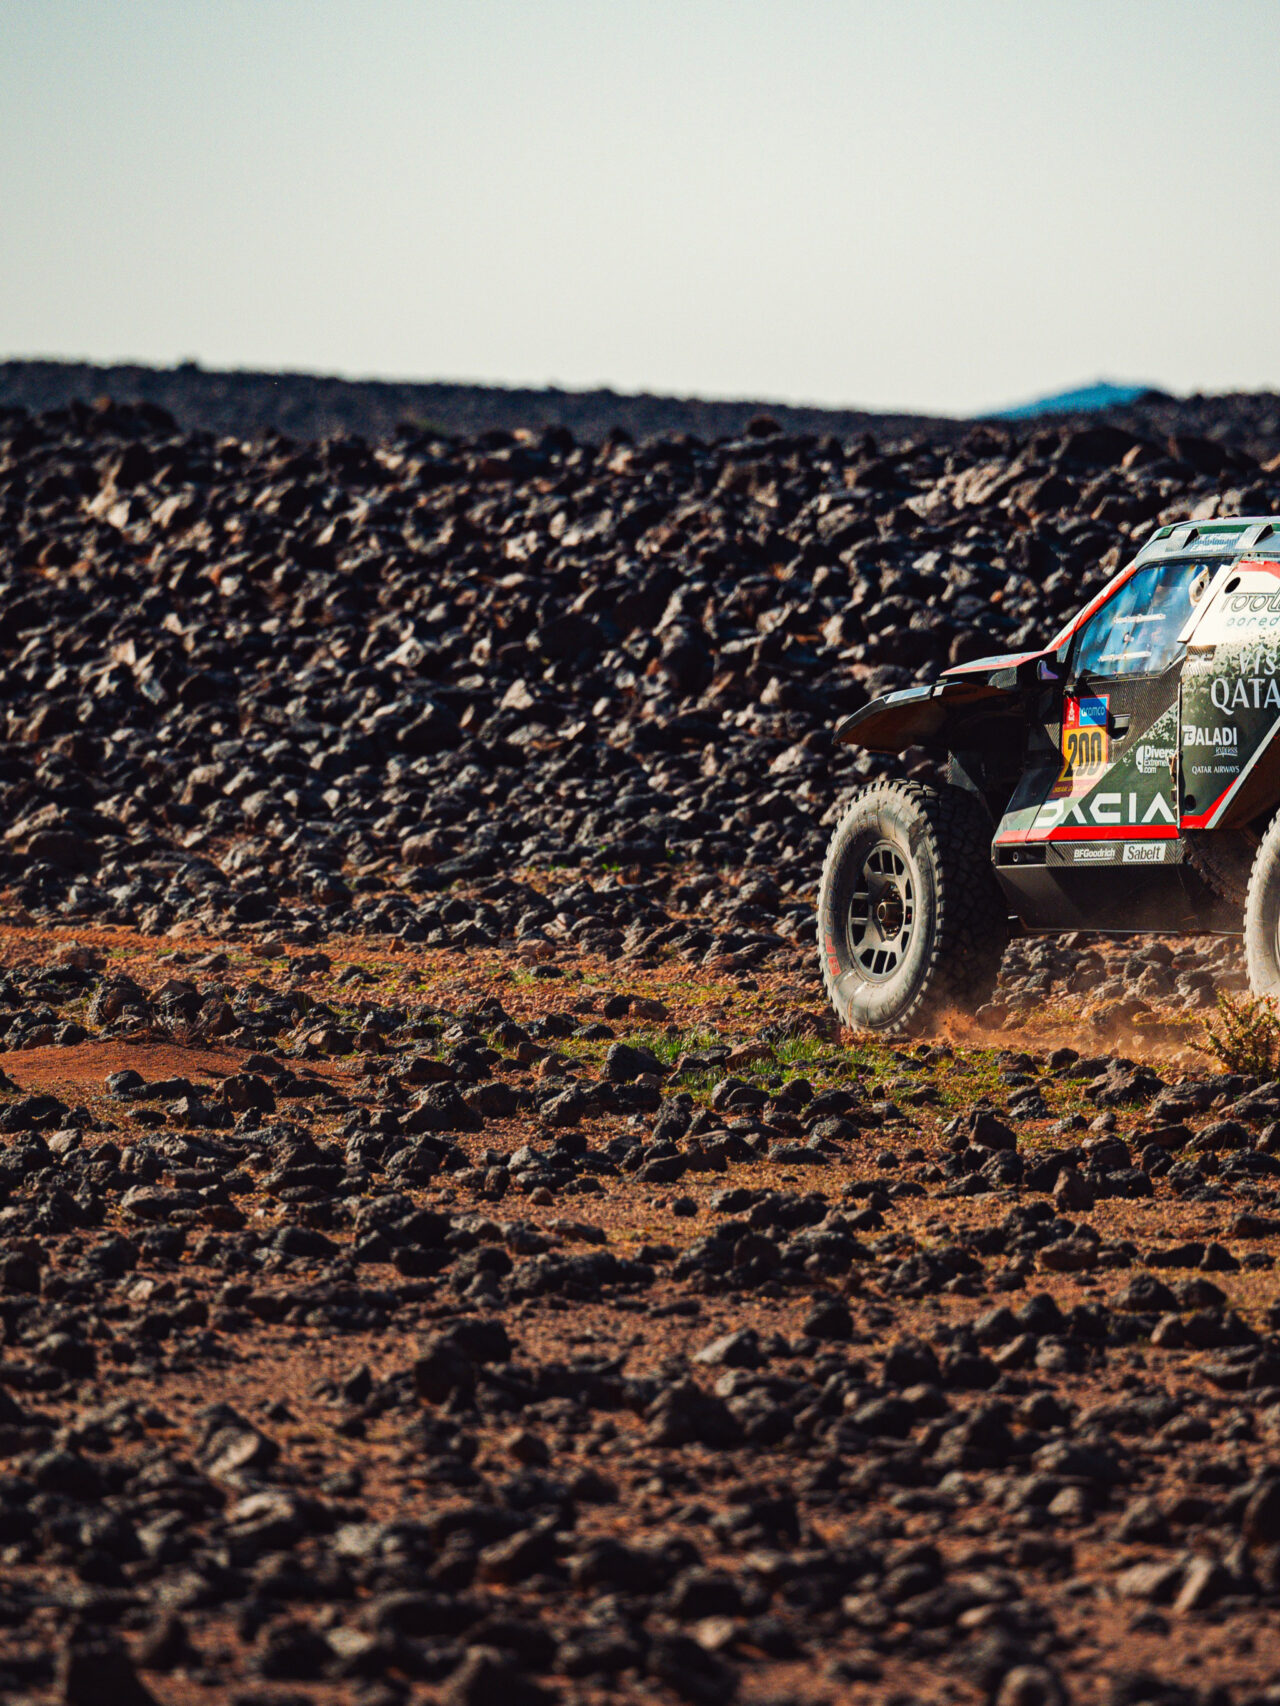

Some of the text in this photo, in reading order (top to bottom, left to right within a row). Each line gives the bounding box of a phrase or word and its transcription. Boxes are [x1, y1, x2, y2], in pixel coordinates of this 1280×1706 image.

[1080, 706, 1105, 717] aramco
[1182, 725, 1238, 746] BALADI
[1063, 732, 1102, 777] 200
[1144, 745, 1177, 758] Divers
[1191, 765, 1239, 775] QATAR AIRWAYS
[1035, 792, 1176, 827] DACIA
[1074, 848, 1115, 858] BFGoodrich
[1127, 845, 1162, 860] Sabelt
